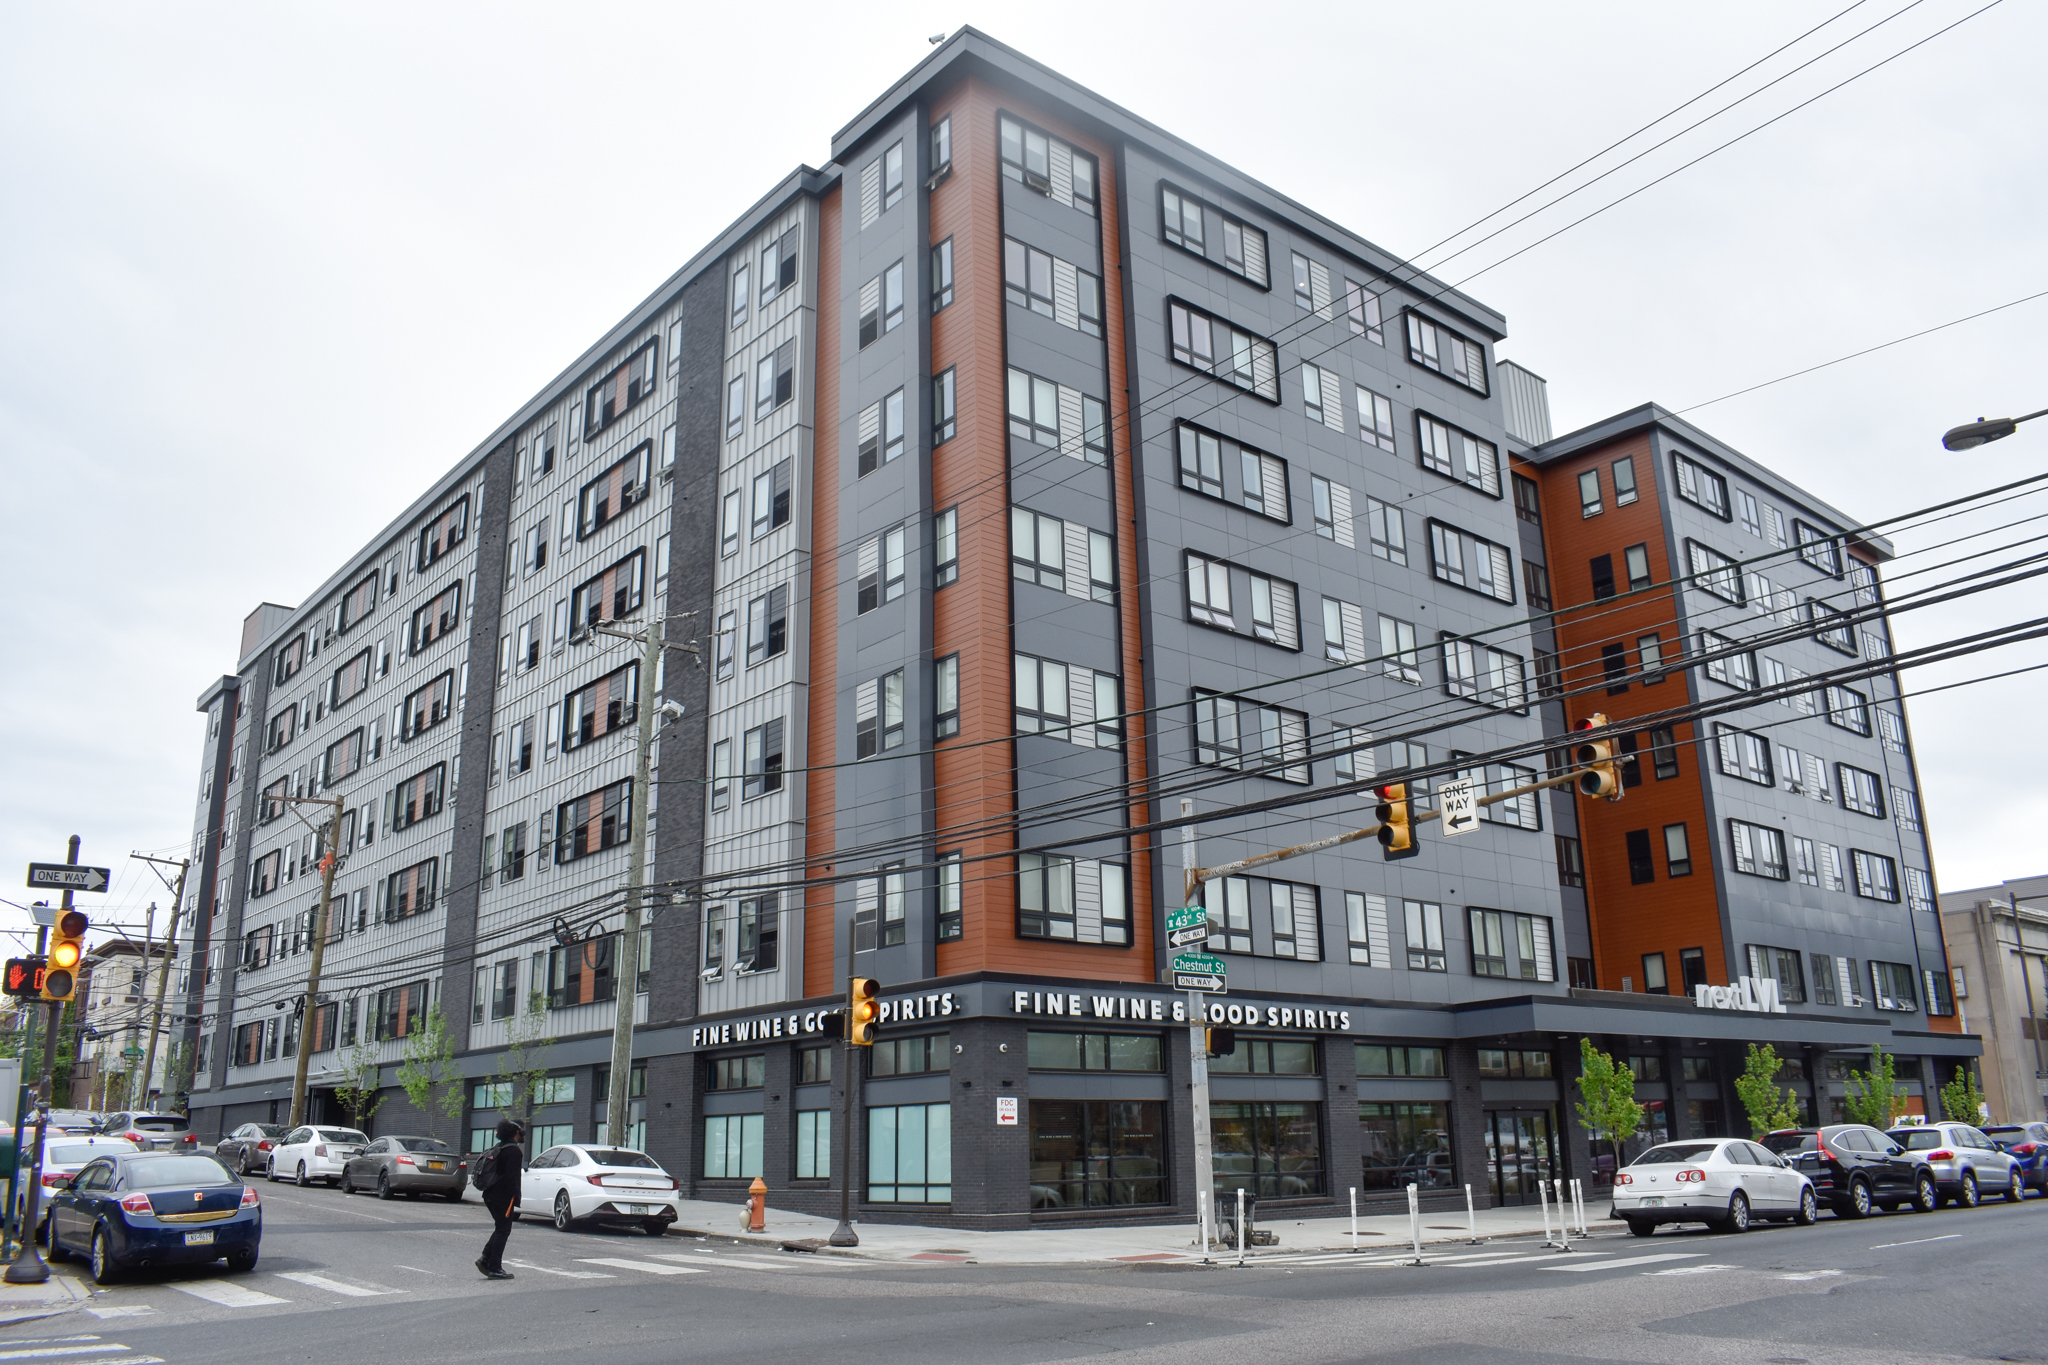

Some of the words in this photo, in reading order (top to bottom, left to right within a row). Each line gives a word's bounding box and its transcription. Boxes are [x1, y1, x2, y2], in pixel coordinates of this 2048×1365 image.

[1444, 782, 1468, 798] ONE
[1445, 797, 1469, 813] WAY
[38, 871, 60, 882] ONE
[64, 872, 88, 883] WAY
[1176, 914, 1192, 927] 43rd
[1196, 911, 1206, 923] St
[1180, 932, 1191, 941] ONE
[1192, 929, 1204, 938] WAY
[1173, 958, 1213, 972] Chestnut
[1215, 962, 1225, 973] St
[1180, 977, 1195, 985] ONE
[1197, 978, 1212, 986] WAY
[1695, 975, 1787, 1013] nextLVL
[1014, 991, 1082, 1016] FINE
[1092, 995, 1163, 1021] WINE
[1172, 1001, 1185, 1022] &
[1202, 1003, 1259, 1026] OOD
[1267, 1006, 1351, 1031] SPIRITS
[692, 1024, 730, 1047] FINE
[736, 1018, 782, 1042] WINE
[788, 1015, 798, 1035] &
[872, 992, 953, 1024] PIRITS
